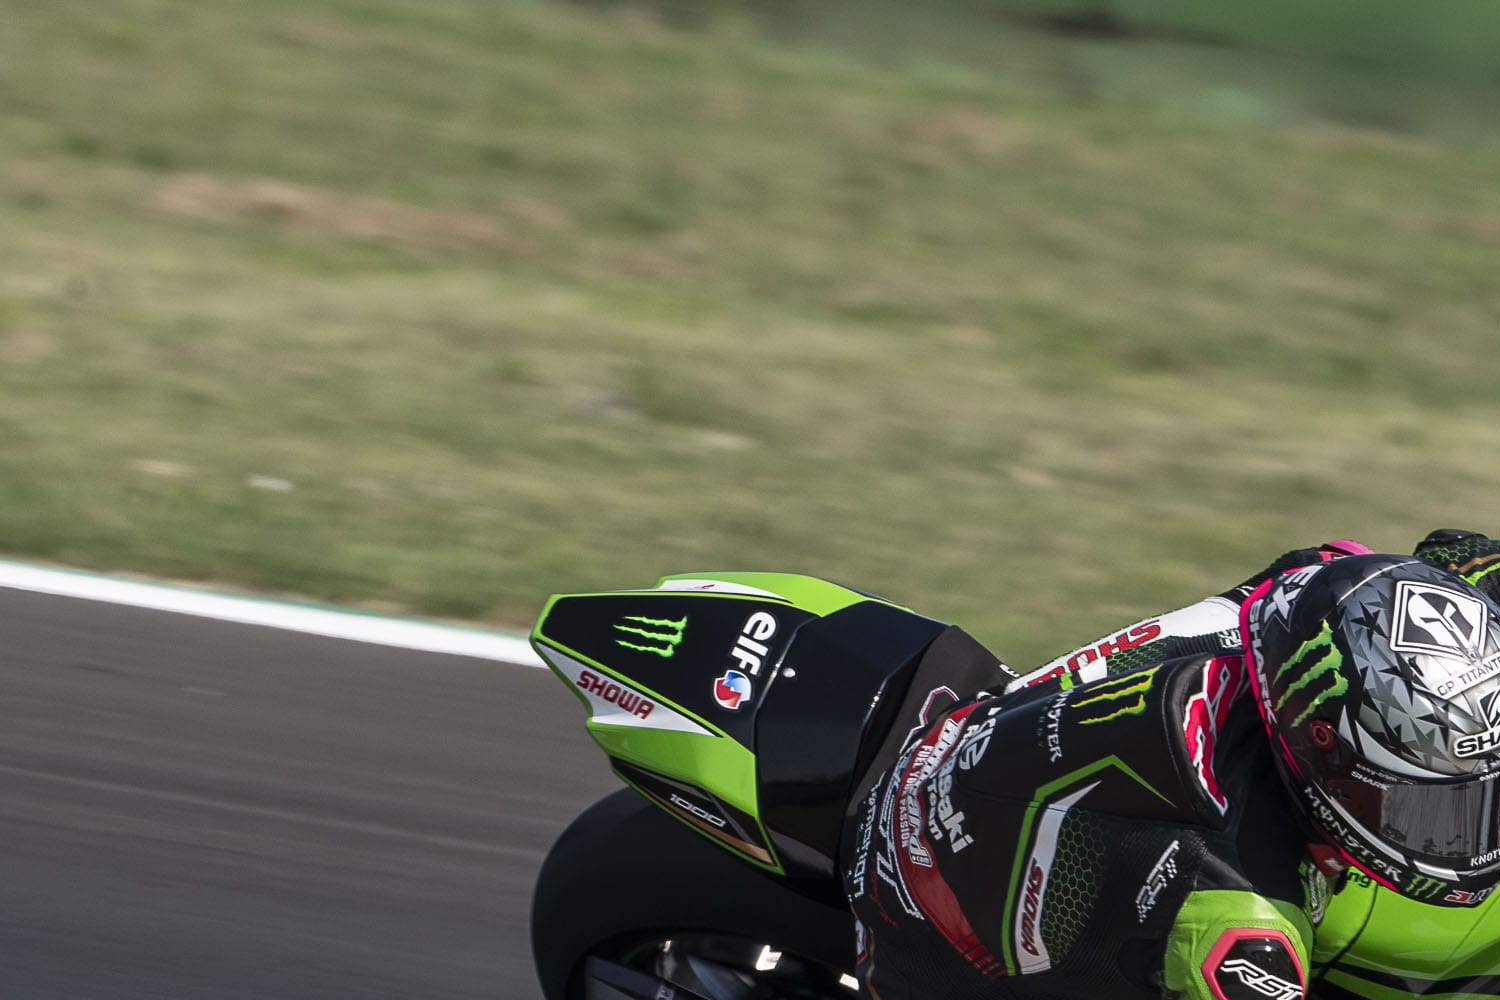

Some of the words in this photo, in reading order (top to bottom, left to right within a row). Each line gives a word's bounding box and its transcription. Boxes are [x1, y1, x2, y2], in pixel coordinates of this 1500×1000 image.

[730, 611, 777, 676] elf
[1249, 598, 1278, 725] SHARK
[575, 670, 655, 720] SHOWA
[669, 793, 727, 829] 1000
[1020, 861, 1043, 956] SHOWA
